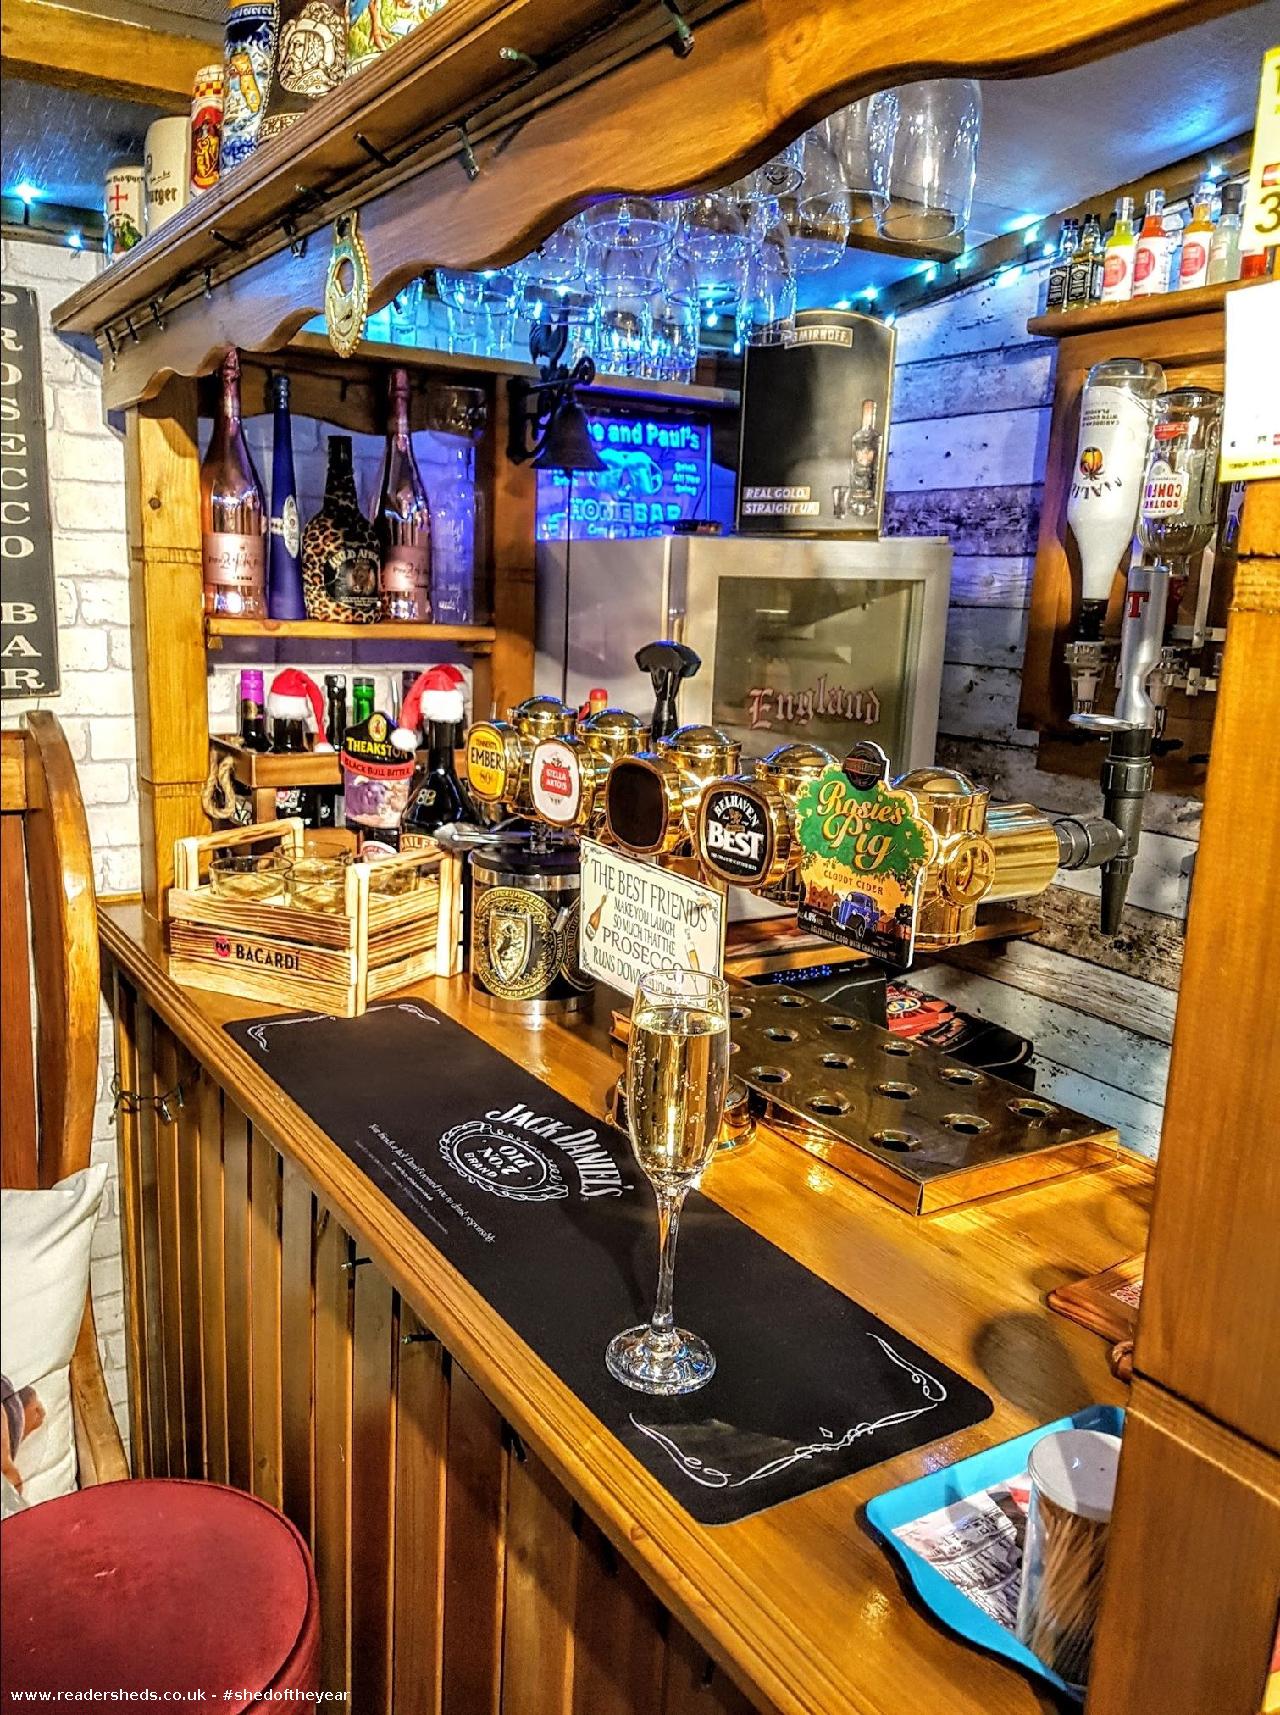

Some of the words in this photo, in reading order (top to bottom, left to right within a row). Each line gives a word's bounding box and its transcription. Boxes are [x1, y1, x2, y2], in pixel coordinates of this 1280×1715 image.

[607, 422, 643, 445] and
[646, 422, 700, 449] Paul's
[745, 488, 772, 499] REAL
[745, 503, 797, 514] STRAIGHT
[1143, 500, 1179, 509] SOUTHE
[1144, 483, 1182, 498] COMFO
[1128, 592, 1150, 617] T
[1, 601, 45, 690] BAR
[747, 673, 881, 731] England
[344, 757, 366, 774] BLACK
[367, 766, 385, 777] BULL
[387, 766, 410, 778] BITTER
[713, 795, 760, 828] BELHAVEN
[816, 780, 906, 825] Rosie's
[707, 819, 765, 860] BEST
[822, 812, 897, 871] Pig
[591, 858, 615, 891] THE
[617, 869, 648, 904] BEST
[650, 884, 708, 931] FRIENDS
[855, 880, 884, 896] CIDER
[613, 913, 623, 930] SO
[622, 918, 643, 941] MUCH
[644, 928, 662, 949] THAT
[662, 936, 676, 957] THE
[614, 896, 634, 918] MAKE
[634, 905, 649, 925] YOU
[651, 913, 676, 938] LAUGH
[593, 945, 615, 973] RUNS
[617, 958, 641, 985] DOW
[463, 1151, 498, 1178] BRAND
[485, 1103, 574, 1139] JACK
[550, 1128, 635, 1198] DANIEL'S
